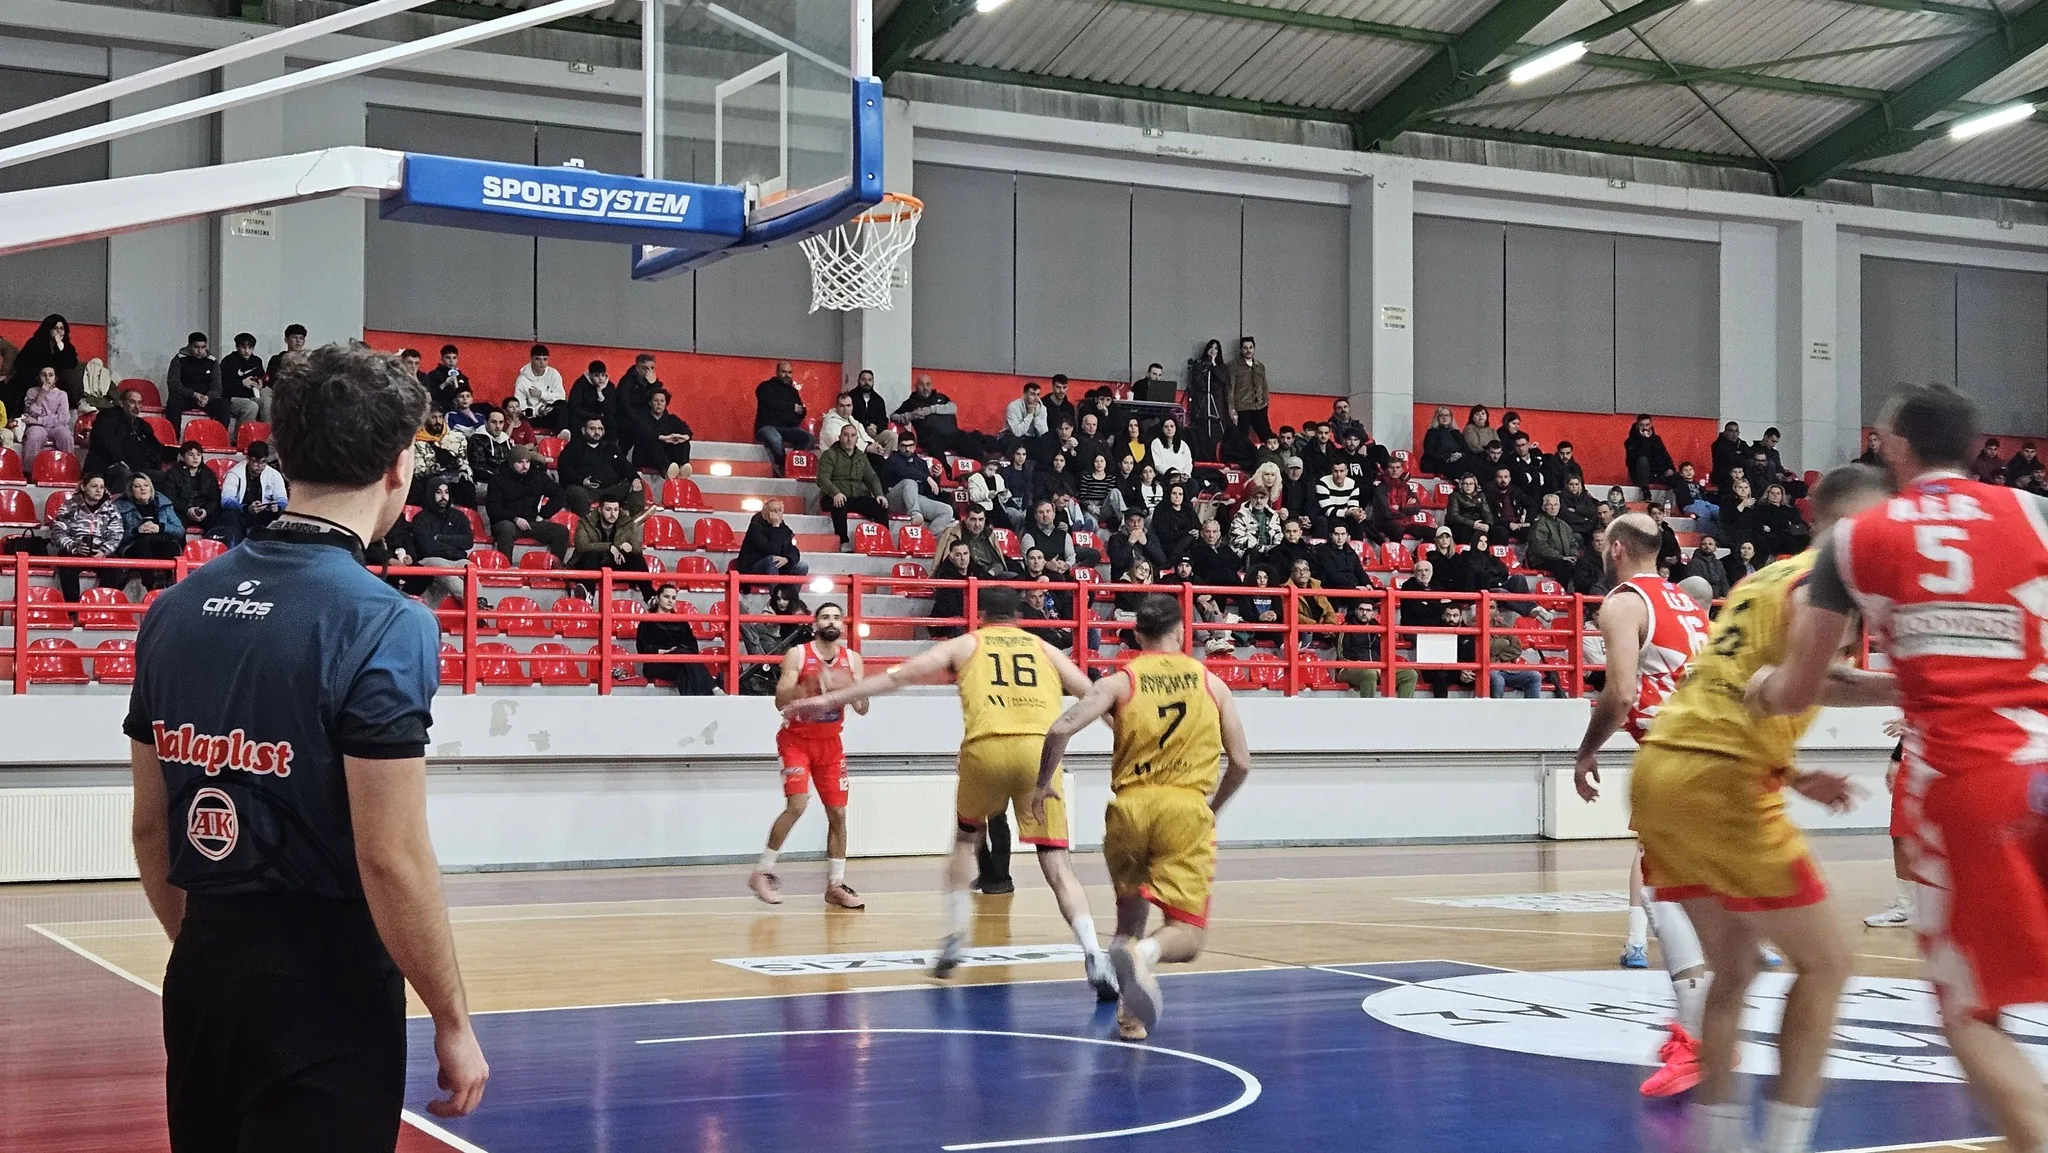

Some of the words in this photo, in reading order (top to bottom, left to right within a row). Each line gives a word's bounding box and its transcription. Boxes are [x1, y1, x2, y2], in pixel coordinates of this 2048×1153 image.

[483, 175, 578, 209] SPORT
[578, 187, 691, 217] SYSTEM
[793, 455, 806, 466] 88
[960, 460, 970, 469] 84
[1441, 485, 1452, 494] 71
[956, 491, 967, 502] 63
[864, 525, 875, 534] 44
[909, 528, 919, 537] 43
[1079, 534, 1088, 543] 39
[1495, 547, 1505, 557] 28
[1914, 525, 1974, 595] 5
[202, 596, 274, 616] athlos
[987, 652, 1037, 687] 16
[1158, 701, 1187, 750] 7
[190, 811, 233, 839] AK
